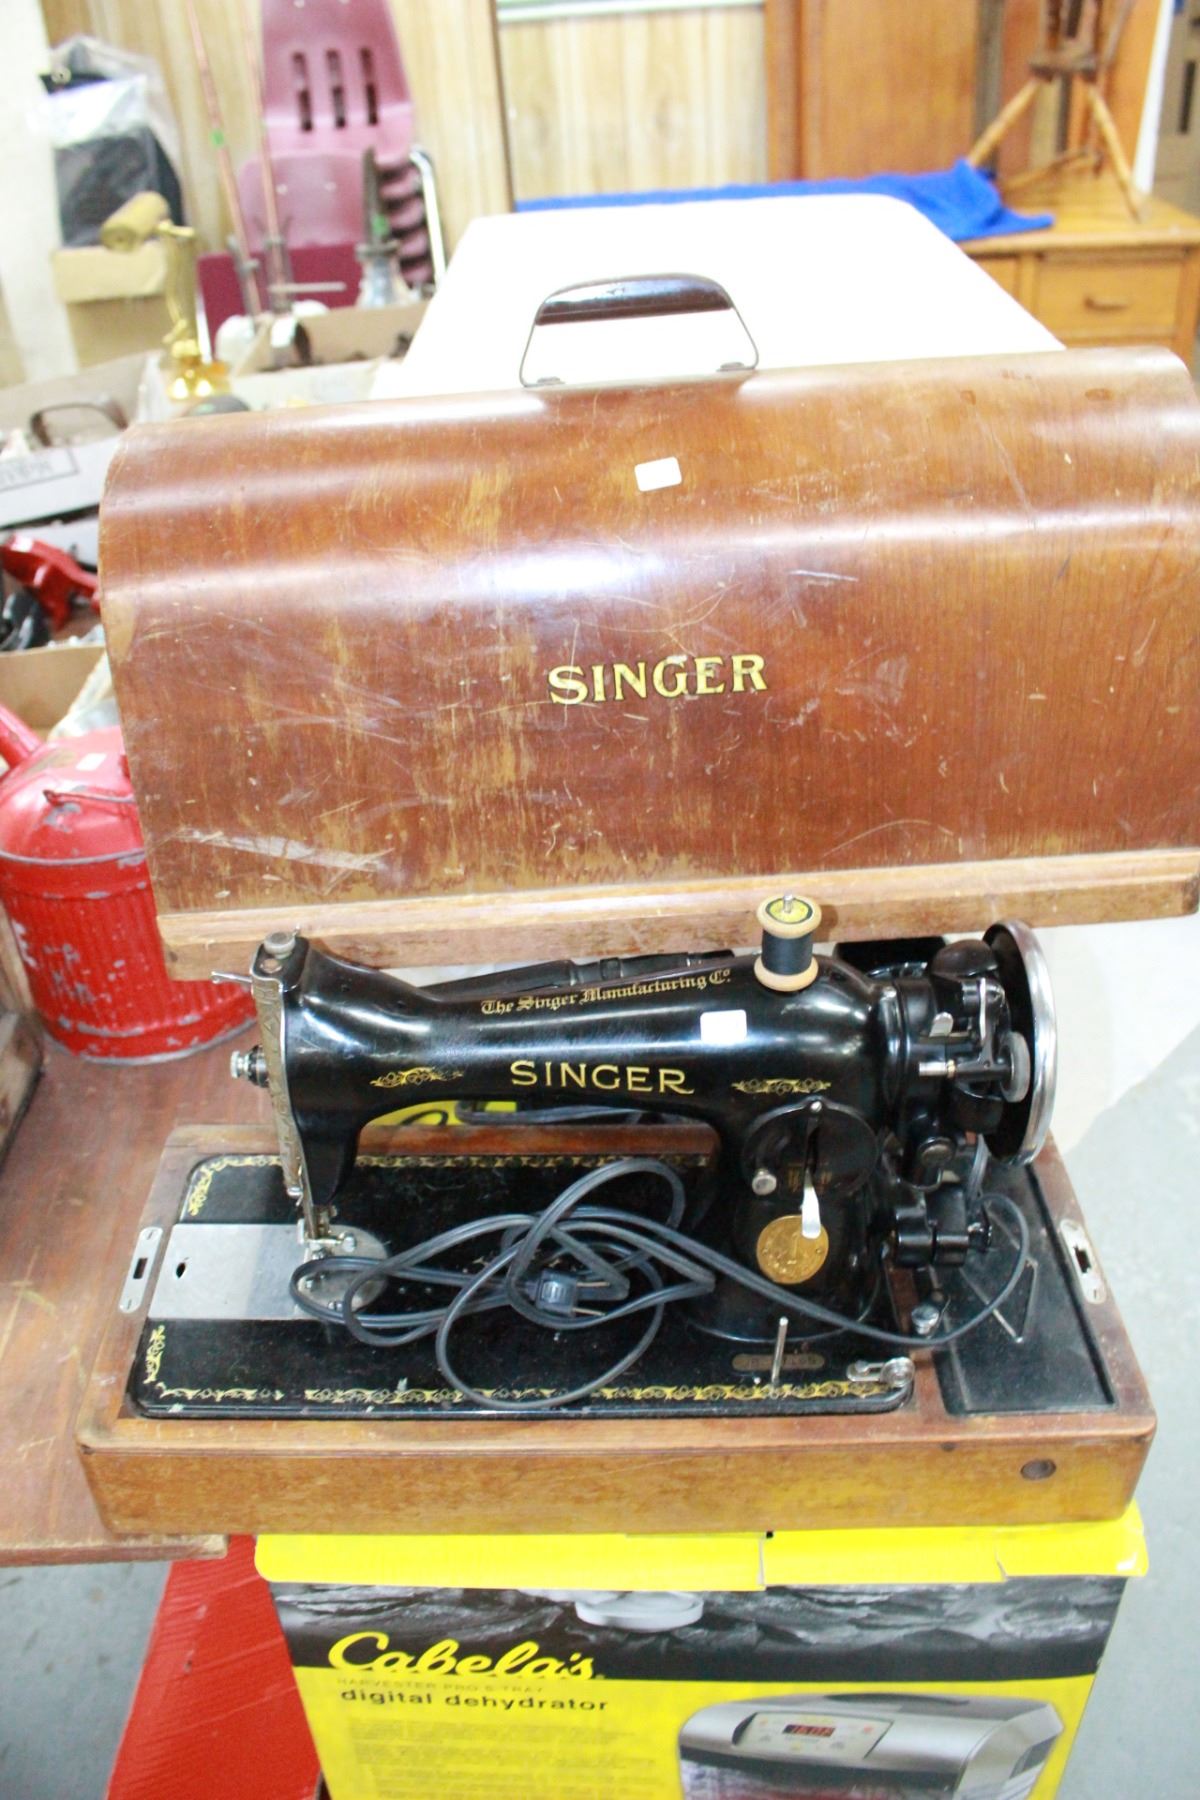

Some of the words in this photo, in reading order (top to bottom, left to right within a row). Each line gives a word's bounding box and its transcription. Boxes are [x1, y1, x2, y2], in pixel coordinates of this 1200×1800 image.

[547, 654, 768, 705] SINGER
[481, 1000, 513, 1015] The
[516, 994, 577, 1010] Singer
[579, 975, 707, 1005] Manufacturing
[510, 1060, 695, 1095] SINGER
[328, 1631, 594, 1680] Cabela's
[341, 1689, 431, 1704] digital
[445, 1696, 608, 1711] dehydrator
